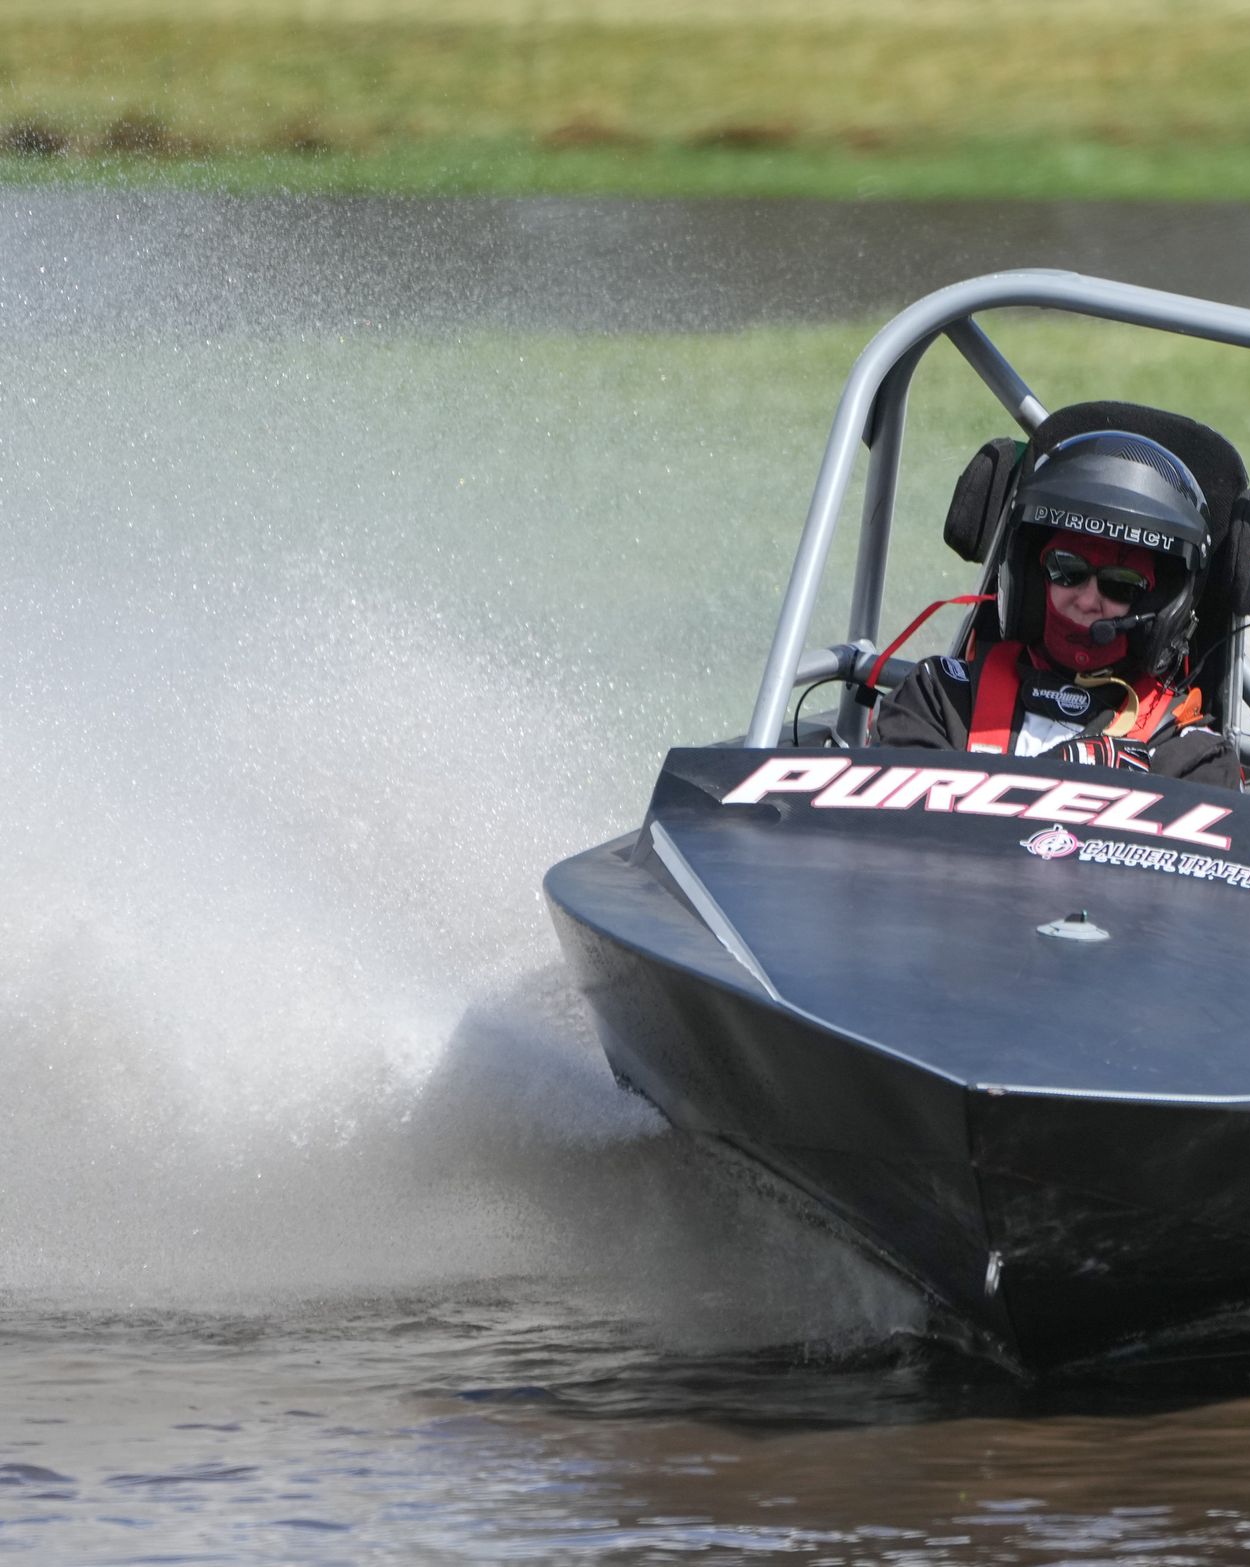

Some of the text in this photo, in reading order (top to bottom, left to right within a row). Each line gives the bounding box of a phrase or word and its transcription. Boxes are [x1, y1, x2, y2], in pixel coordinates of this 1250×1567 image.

[1034, 505, 1175, 551] PYROTECT
[721, 756, 1233, 851] PURCELL
[1080, 839, 1178, 868] CALIBER
